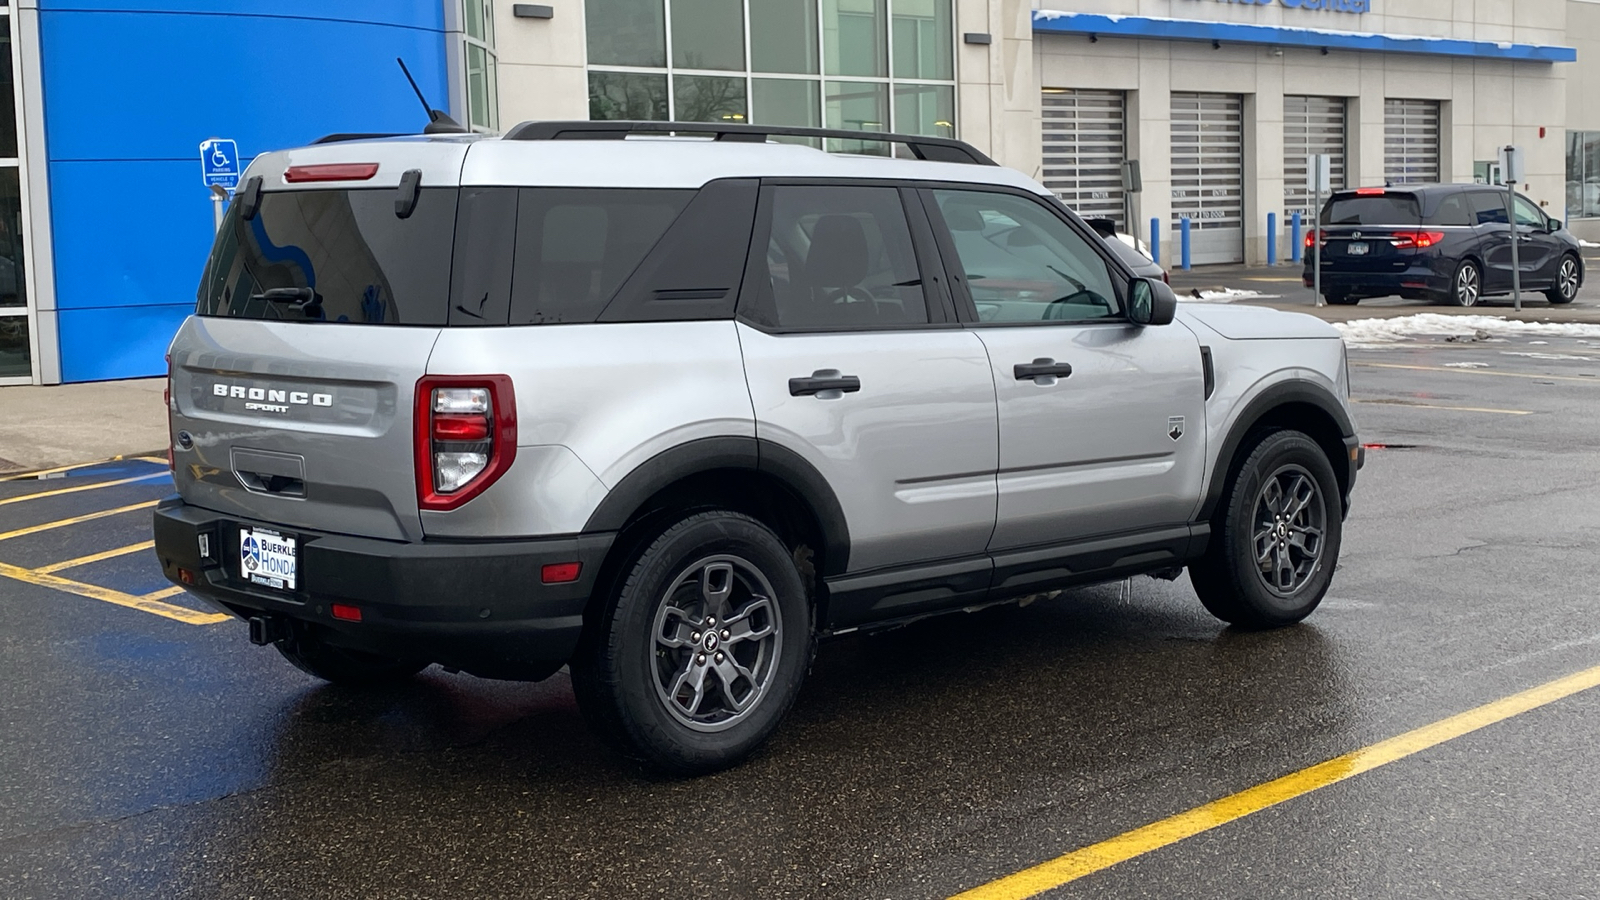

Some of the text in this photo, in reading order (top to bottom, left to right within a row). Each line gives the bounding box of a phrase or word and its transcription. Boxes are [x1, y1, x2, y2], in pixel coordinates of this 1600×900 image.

[213, 383, 333, 407] BRONCO
[245, 402, 289, 413] SPORT
[261, 539, 296, 557] BUERKLE
[261, 552, 296, 576] HONDA
